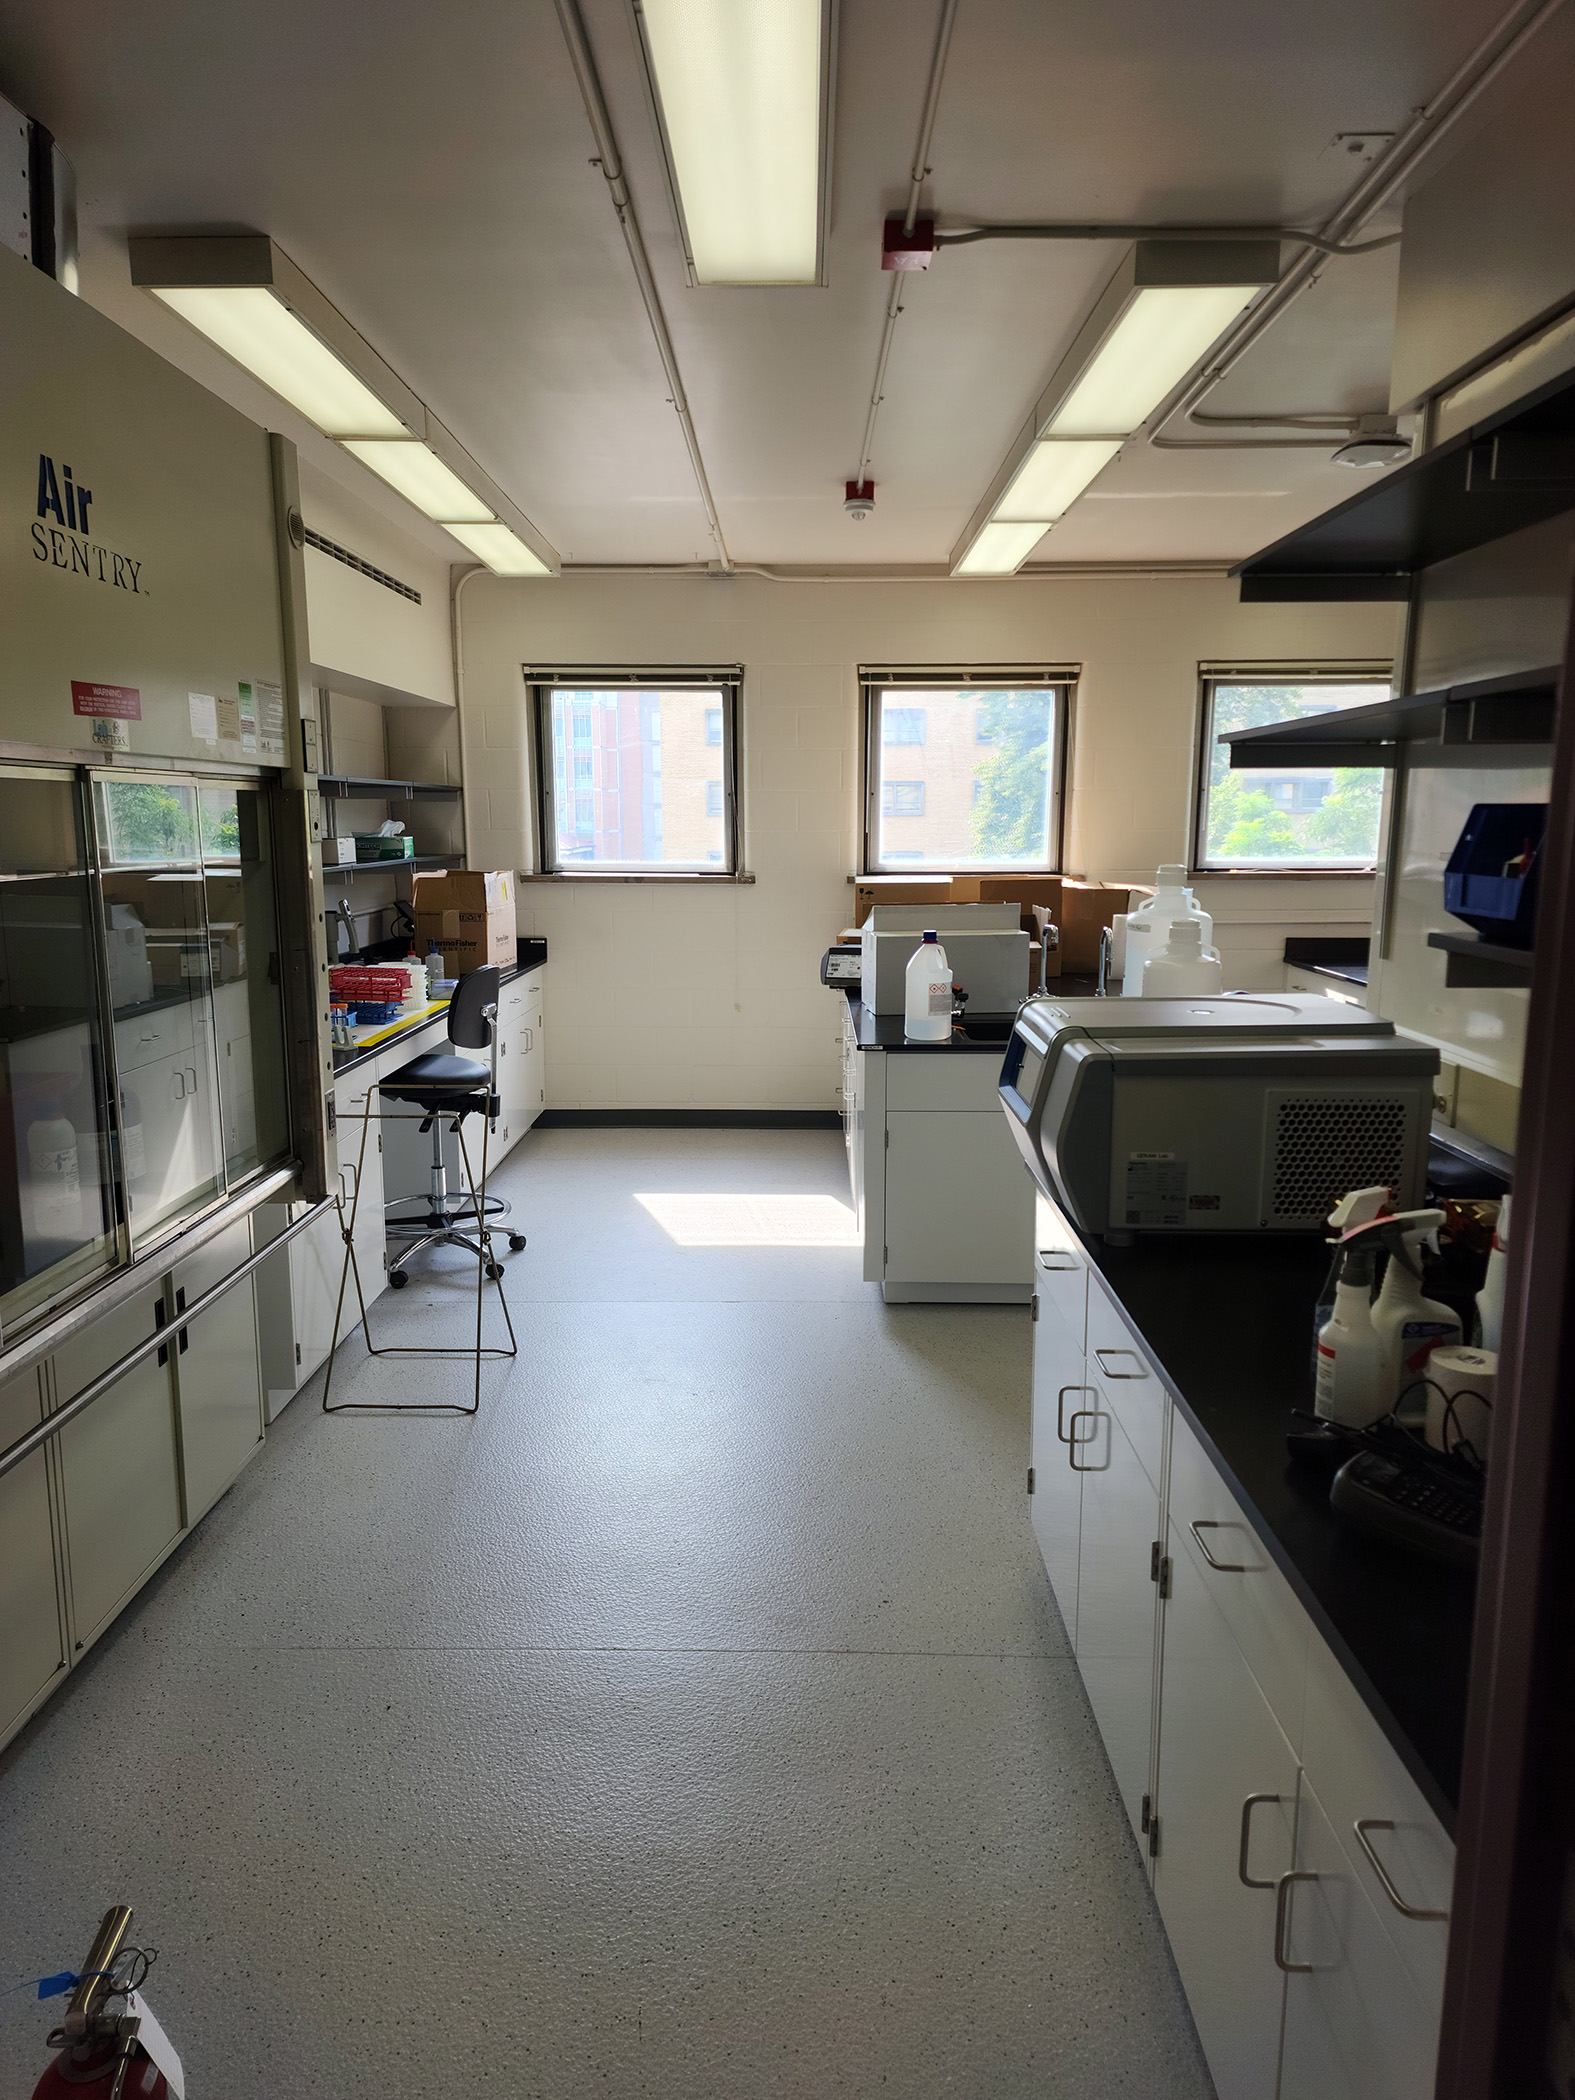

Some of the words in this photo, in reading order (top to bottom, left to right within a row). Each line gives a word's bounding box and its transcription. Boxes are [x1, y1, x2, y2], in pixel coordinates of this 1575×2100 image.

[37, 453, 93, 535] Air
[31, 522, 142, 594] SENTRY
[92, 687, 122, 697] WARNING
